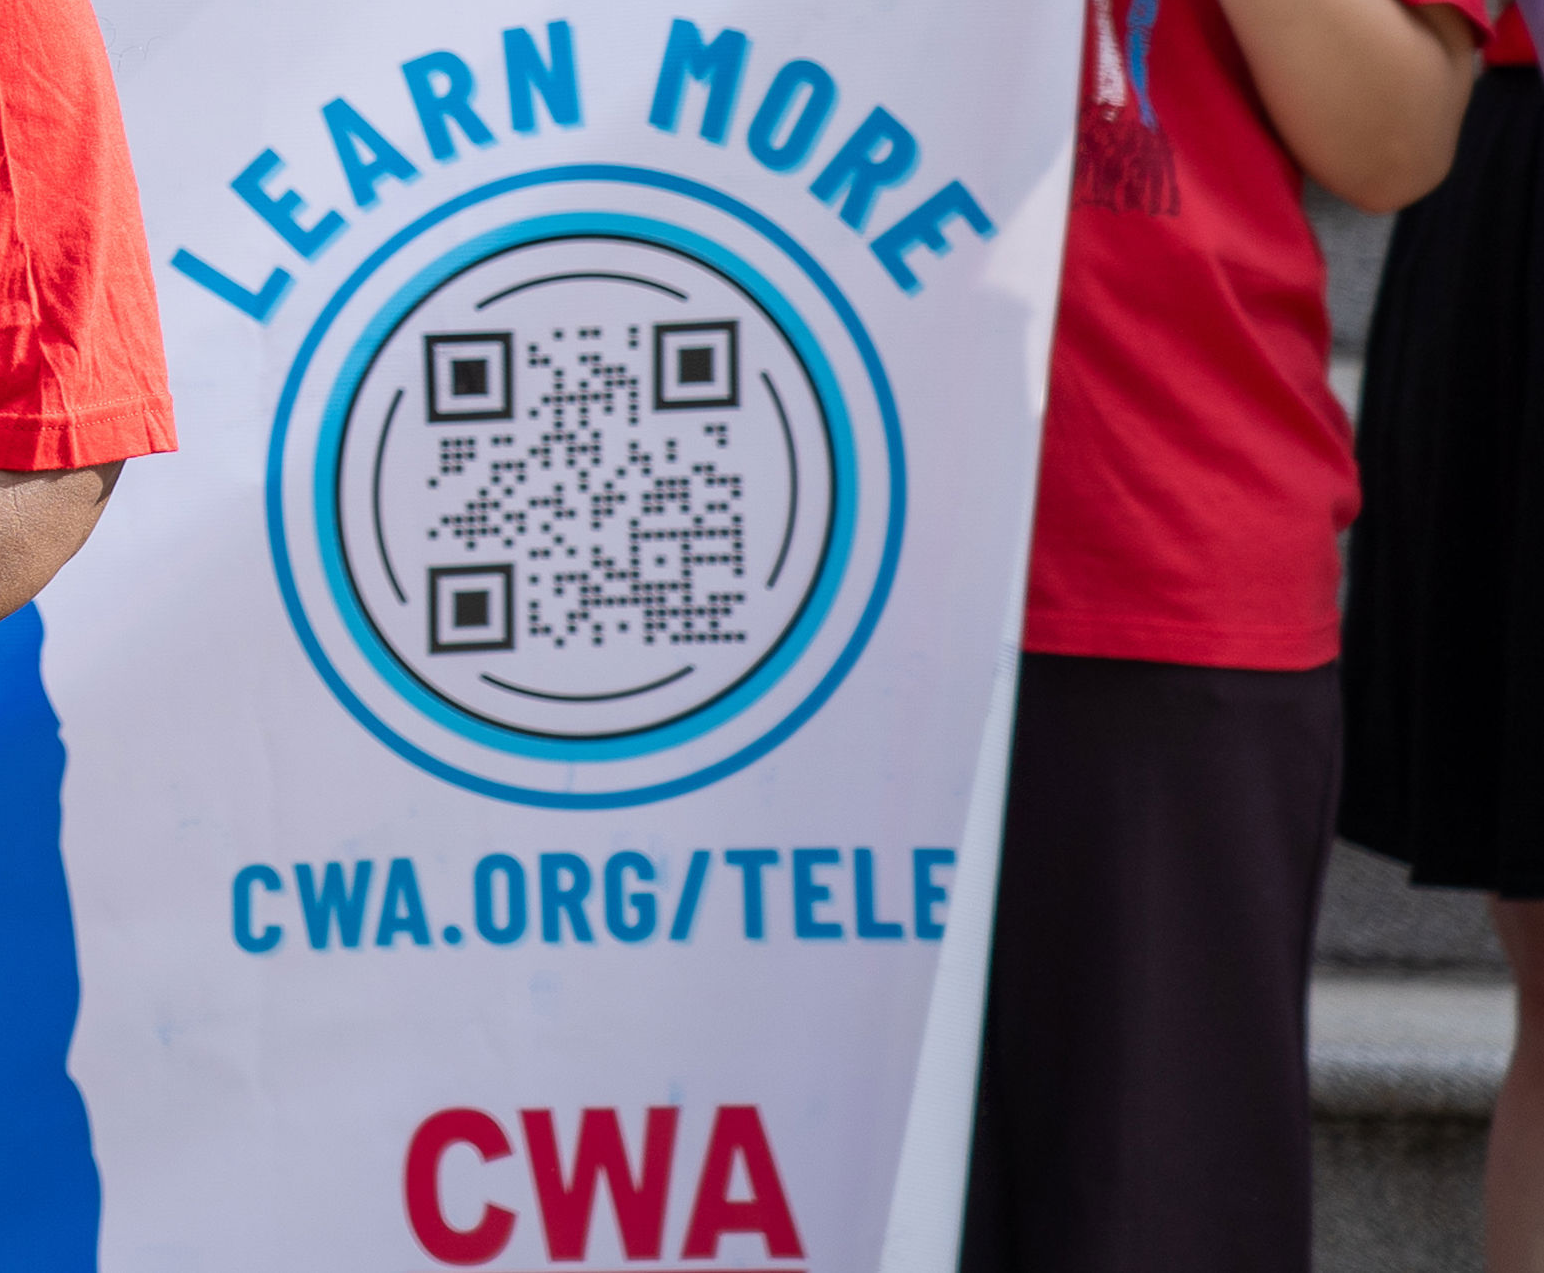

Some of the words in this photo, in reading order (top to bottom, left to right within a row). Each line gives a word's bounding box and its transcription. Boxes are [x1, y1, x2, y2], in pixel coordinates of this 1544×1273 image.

[171, 17, 585, 324] LEARN
[647, 17, 999, 297] MORE
[231, 846, 959, 955] CWA.ORG/TELE
[402, 1104, 807, 1268] CWA
